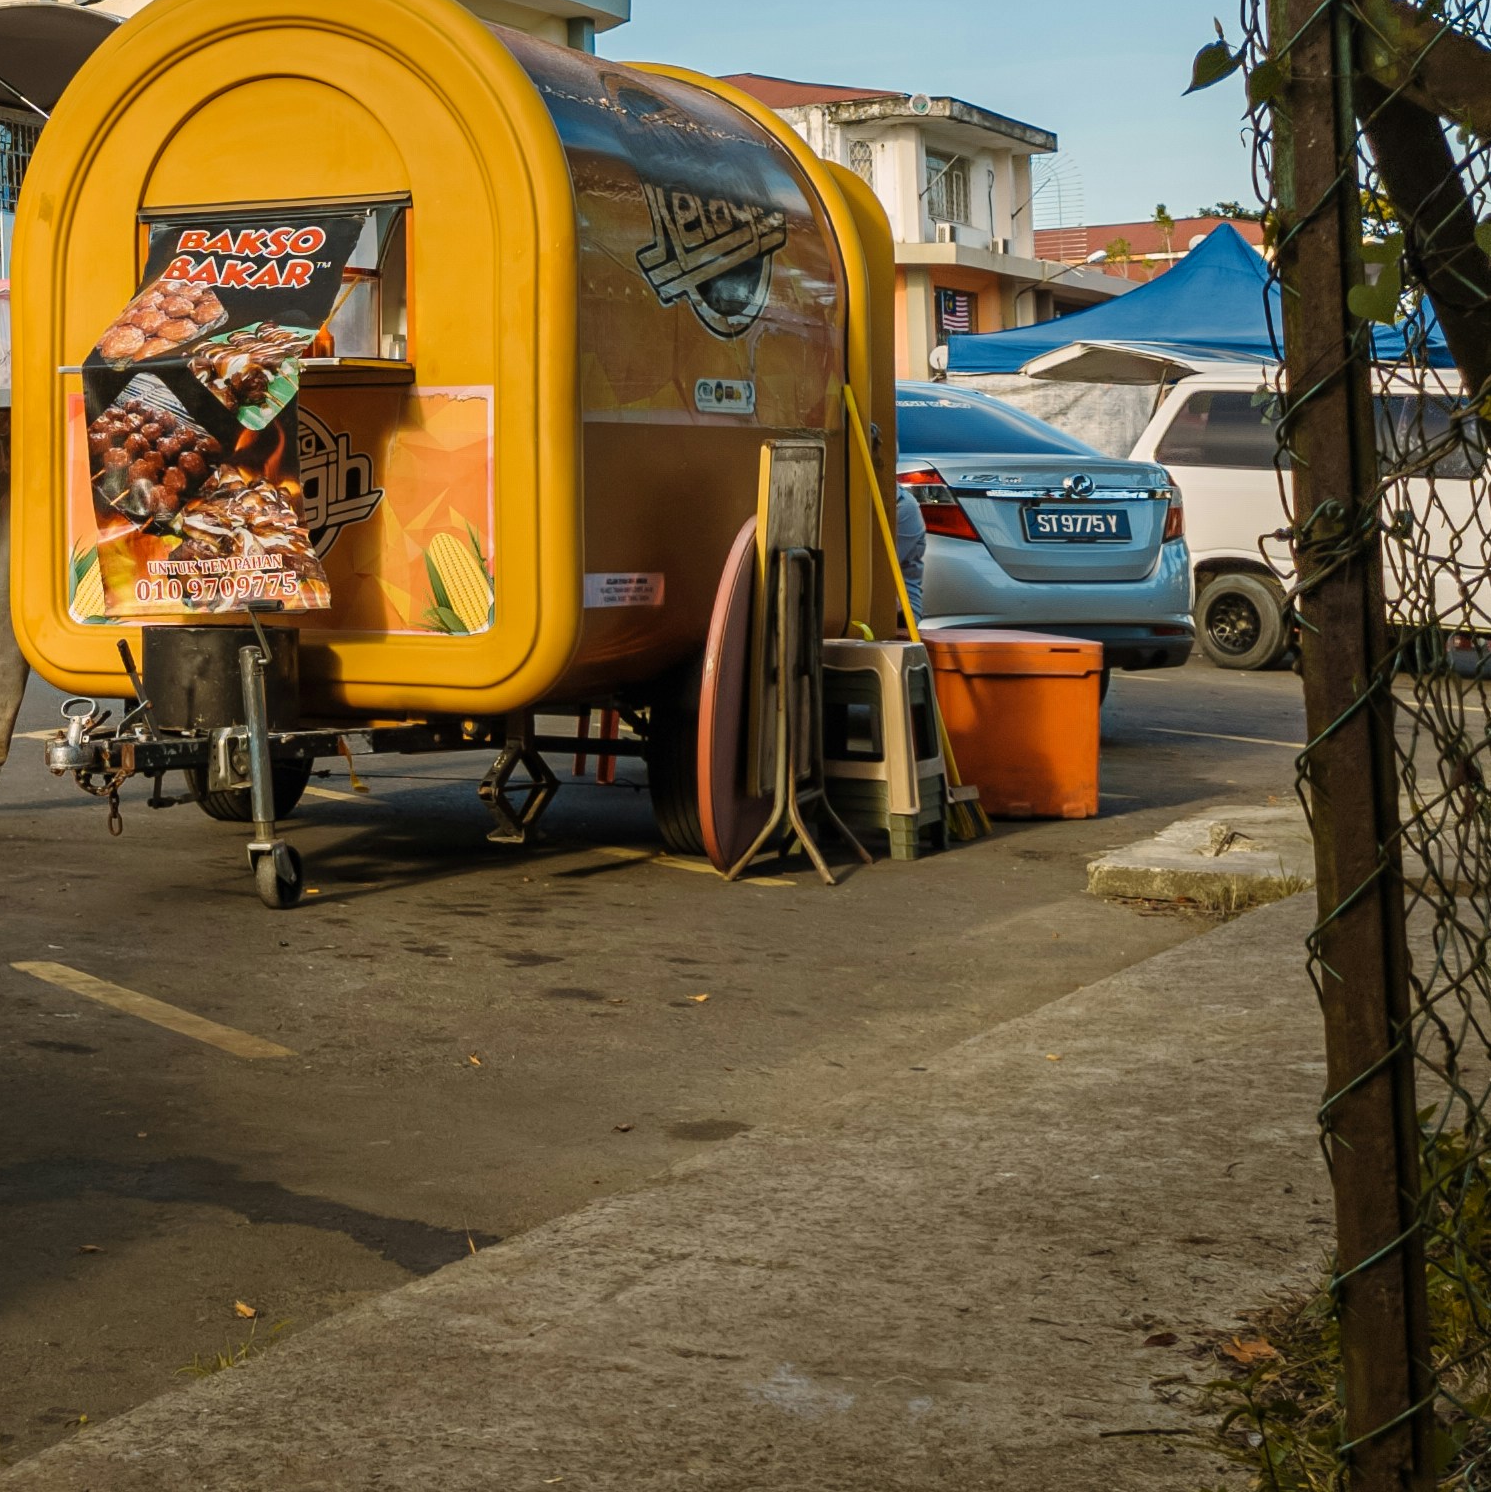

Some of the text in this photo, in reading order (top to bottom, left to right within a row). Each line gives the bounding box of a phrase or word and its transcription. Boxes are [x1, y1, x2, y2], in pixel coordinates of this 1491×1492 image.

[176, 226, 326, 258] BAKSO
[159, 255, 332, 289] BAKAR TM
[1037, 514, 1118, 533] ST 9775 Y
[147, 554, 283, 576] UNTUK TEMPAHAN
[135, 572, 299, 602] 010 9709775
